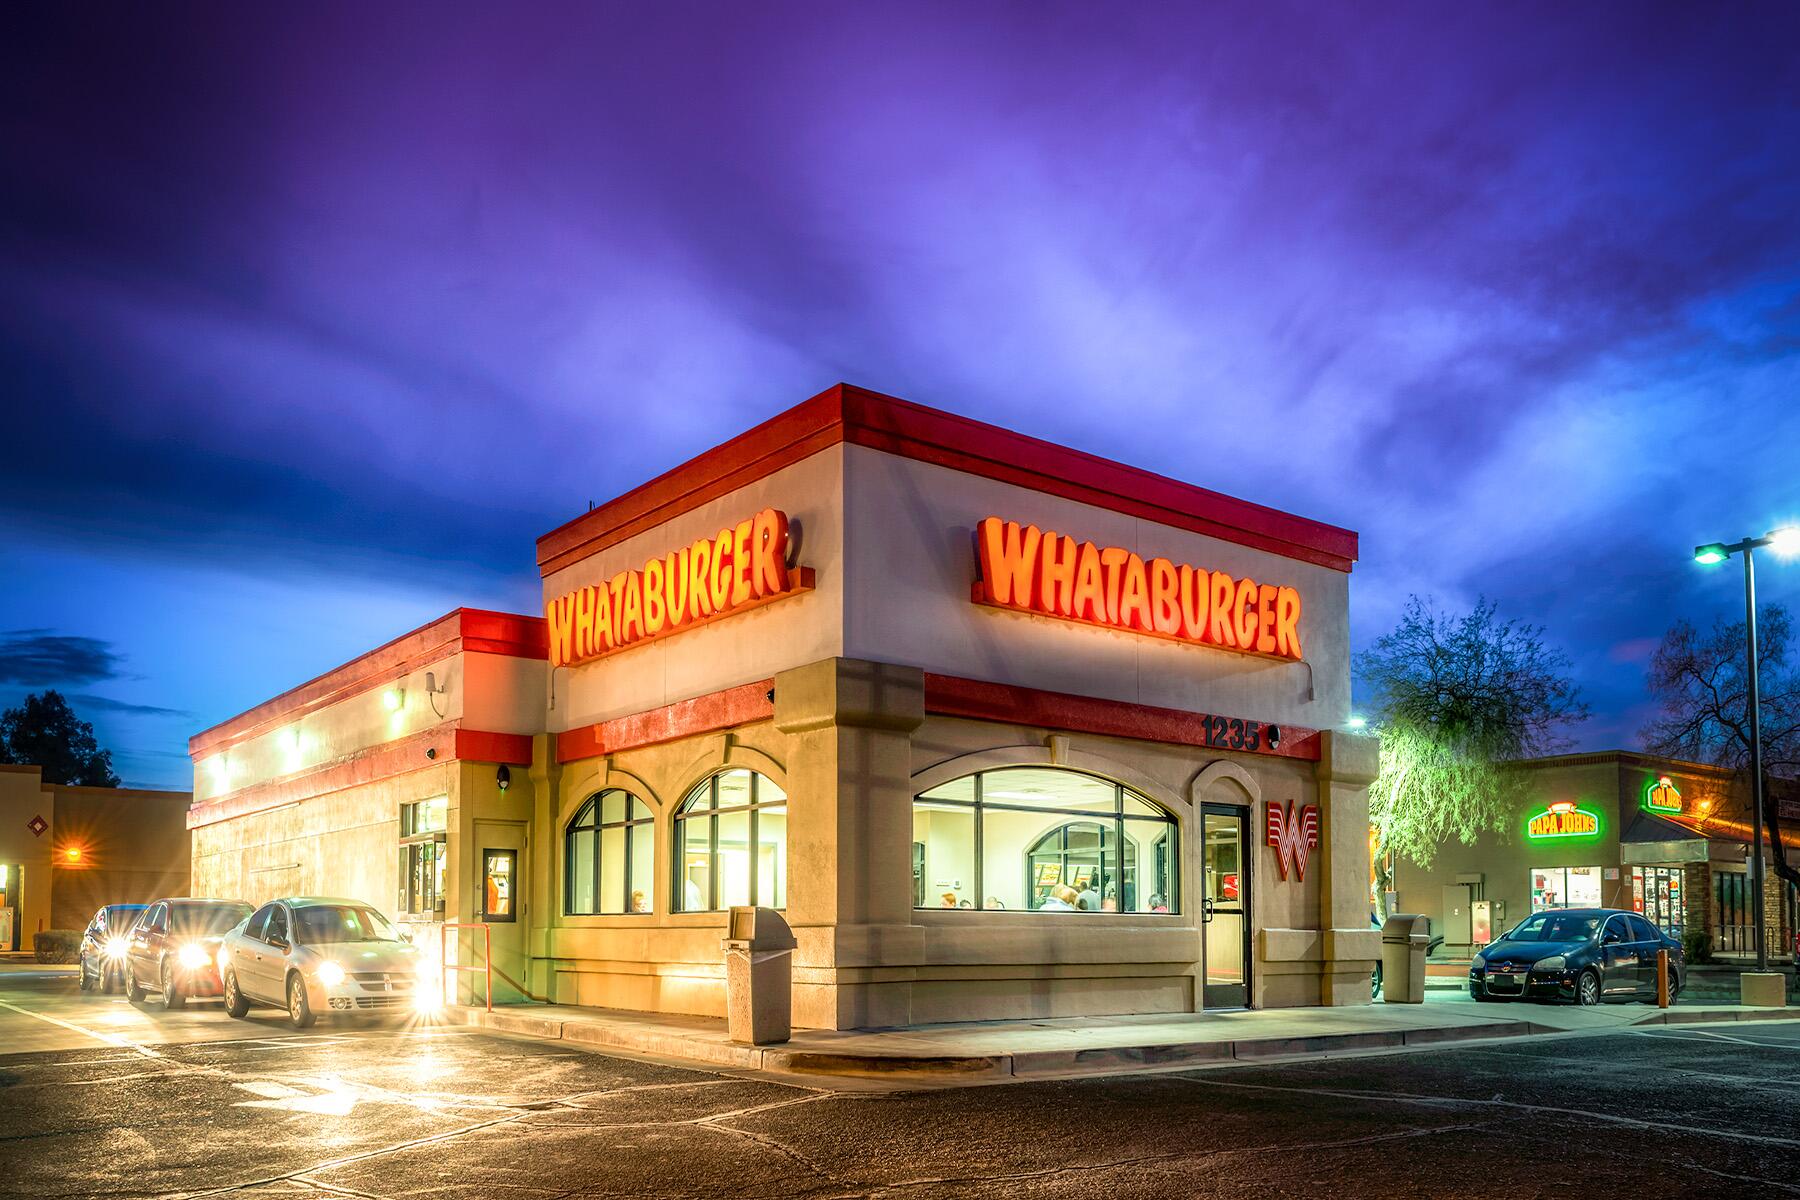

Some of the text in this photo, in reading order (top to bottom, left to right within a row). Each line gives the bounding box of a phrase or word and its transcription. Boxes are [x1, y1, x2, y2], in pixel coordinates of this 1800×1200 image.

[547, 508, 788, 667] WHATABURGER
[977, 516, 1303, 659] WHATABURGER
[1202, 714, 1259, 750] 1235
[1265, 799, 1318, 882] W
[1530, 812, 1595, 834] PAPA JOHNS
